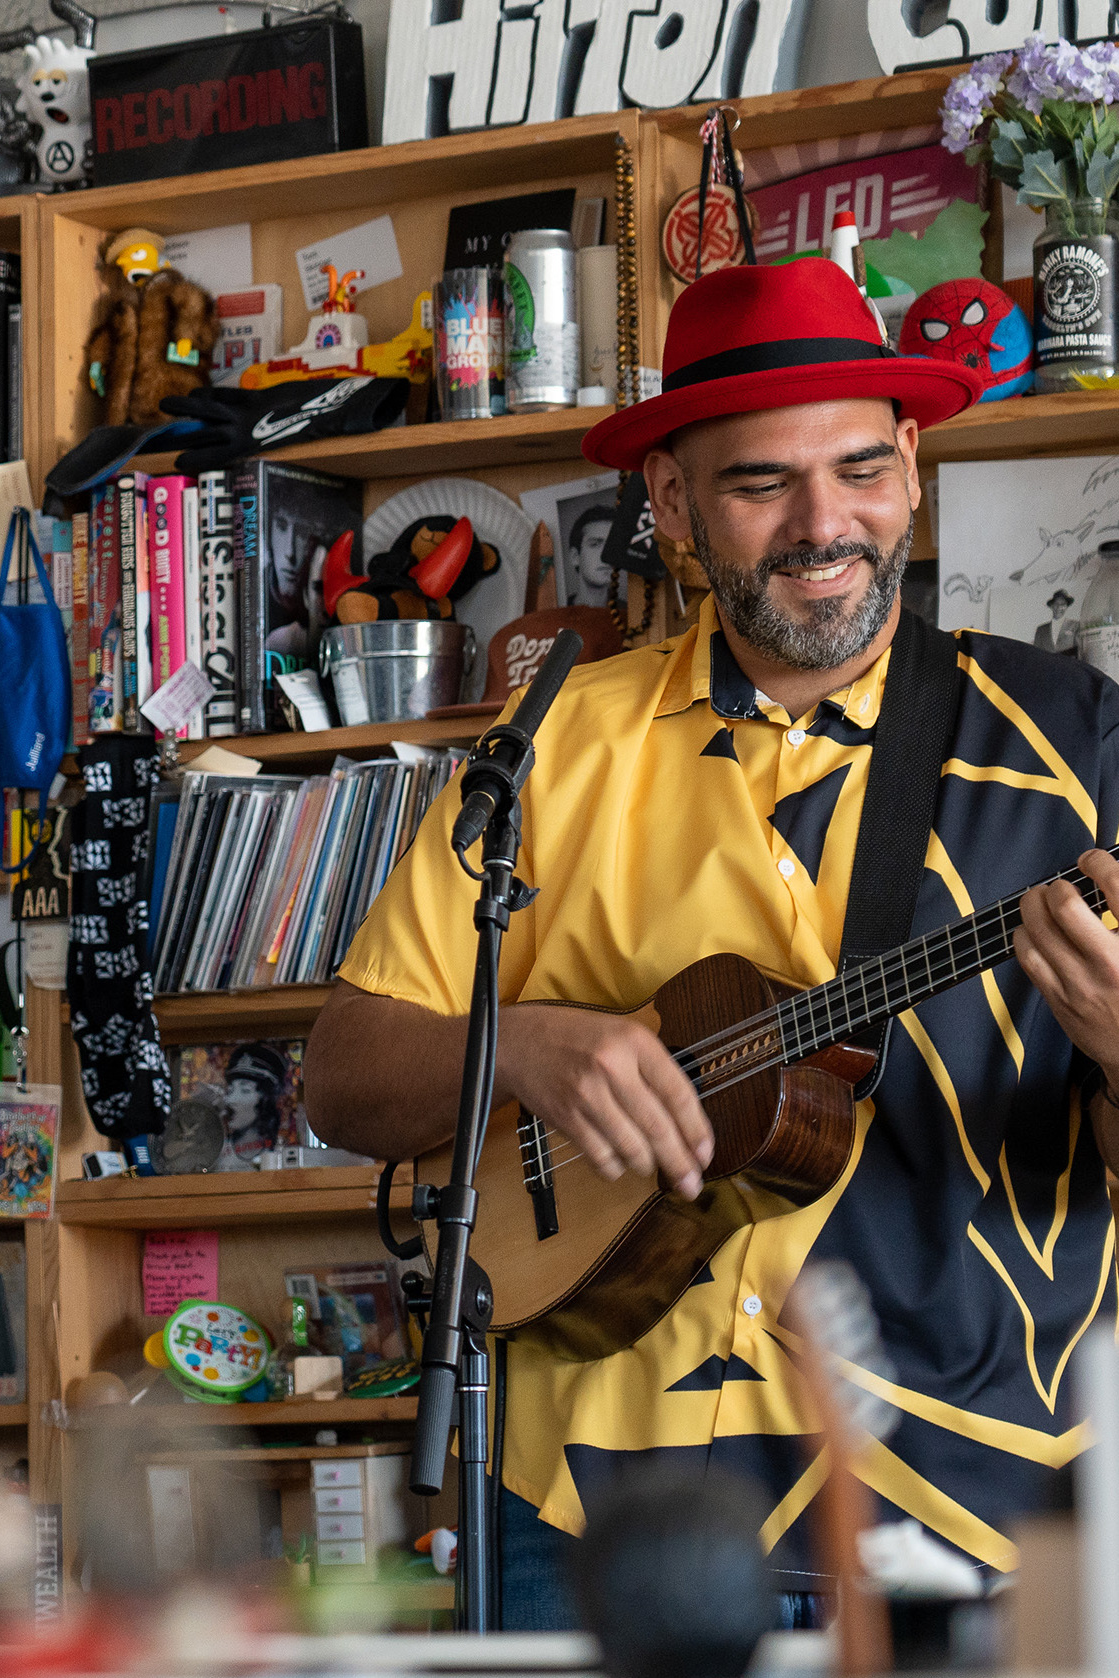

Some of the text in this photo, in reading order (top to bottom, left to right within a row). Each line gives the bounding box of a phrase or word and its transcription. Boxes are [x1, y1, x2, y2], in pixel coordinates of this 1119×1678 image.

[95, 62, 328, 154] RECORDING
[446, 318, 503, 336] BLUE
[1065, 333, 1088, 347] PASTA
[1088, 333, 1112, 347] SAUCE
[446, 336, 503, 355] MAN
[200, 471, 234, 566] THIS
[239, 494, 258, 559] DREAM
[153, 486, 171, 585] GOOD BOOTY
[158, 615, 170, 644] ANN
[203, 611, 226, 640] a
[205, 648, 236, 738] CALL
[21, 886, 60, 918] AAA
